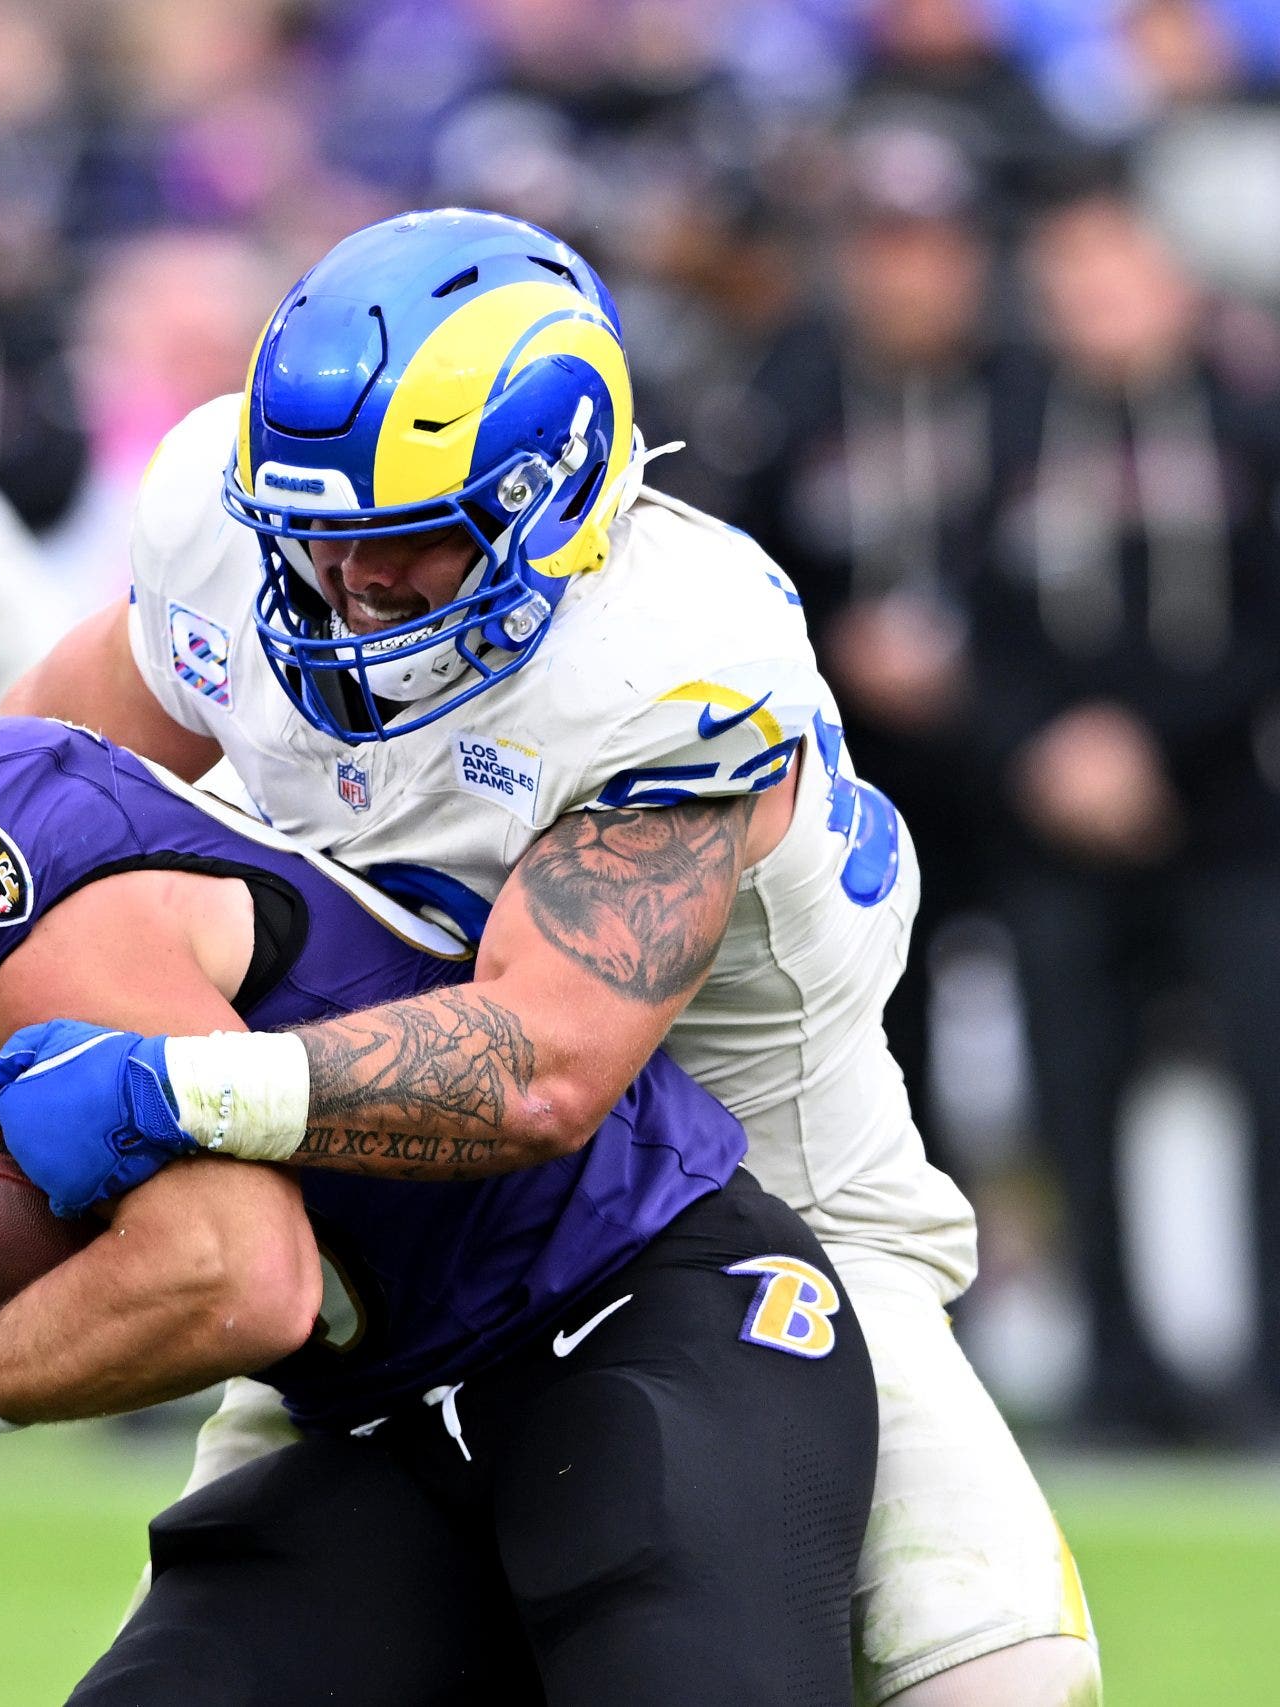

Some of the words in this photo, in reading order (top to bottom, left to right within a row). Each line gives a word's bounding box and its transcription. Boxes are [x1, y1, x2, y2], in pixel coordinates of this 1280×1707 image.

[265, 472, 326, 495] RAMS
[459, 741, 498, 761] LOS
[462, 756, 534, 792] ANGELES
[463, 769, 514, 796] RAMS
[341, 780, 367, 804] NFL
[720, 1254, 840, 1360] B
